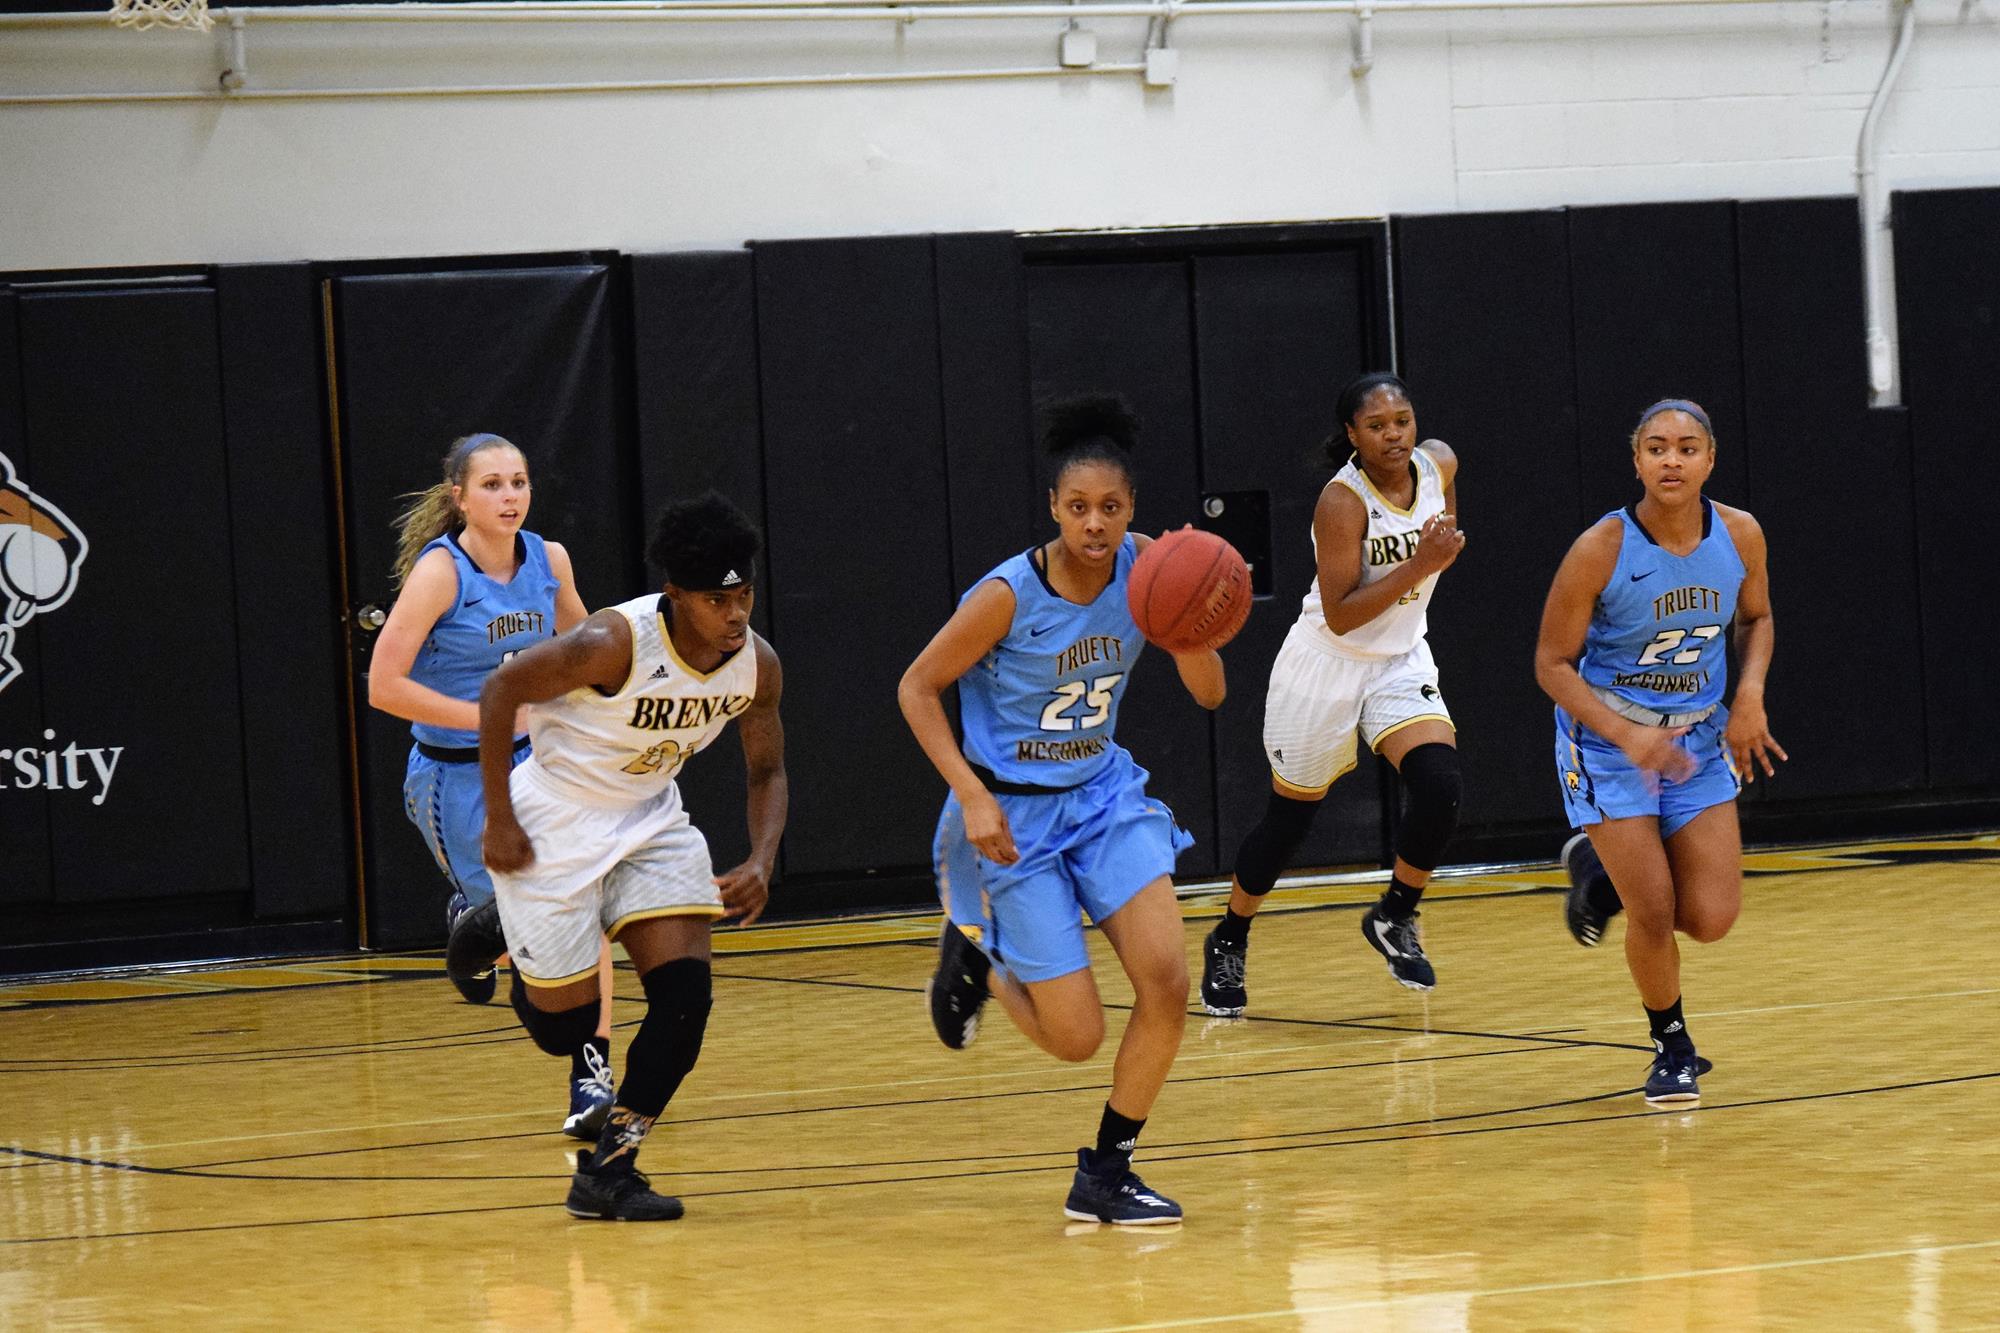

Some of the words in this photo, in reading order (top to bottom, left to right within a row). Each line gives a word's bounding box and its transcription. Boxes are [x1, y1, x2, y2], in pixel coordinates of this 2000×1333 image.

[1653, 586, 1721, 622] TRUETT
[486, 611, 544, 646] TRUETT
[1637, 624, 1722, 666] 22
[1056, 637, 1123, 676] TRUETT
[1038, 672, 1124, 732] 25
